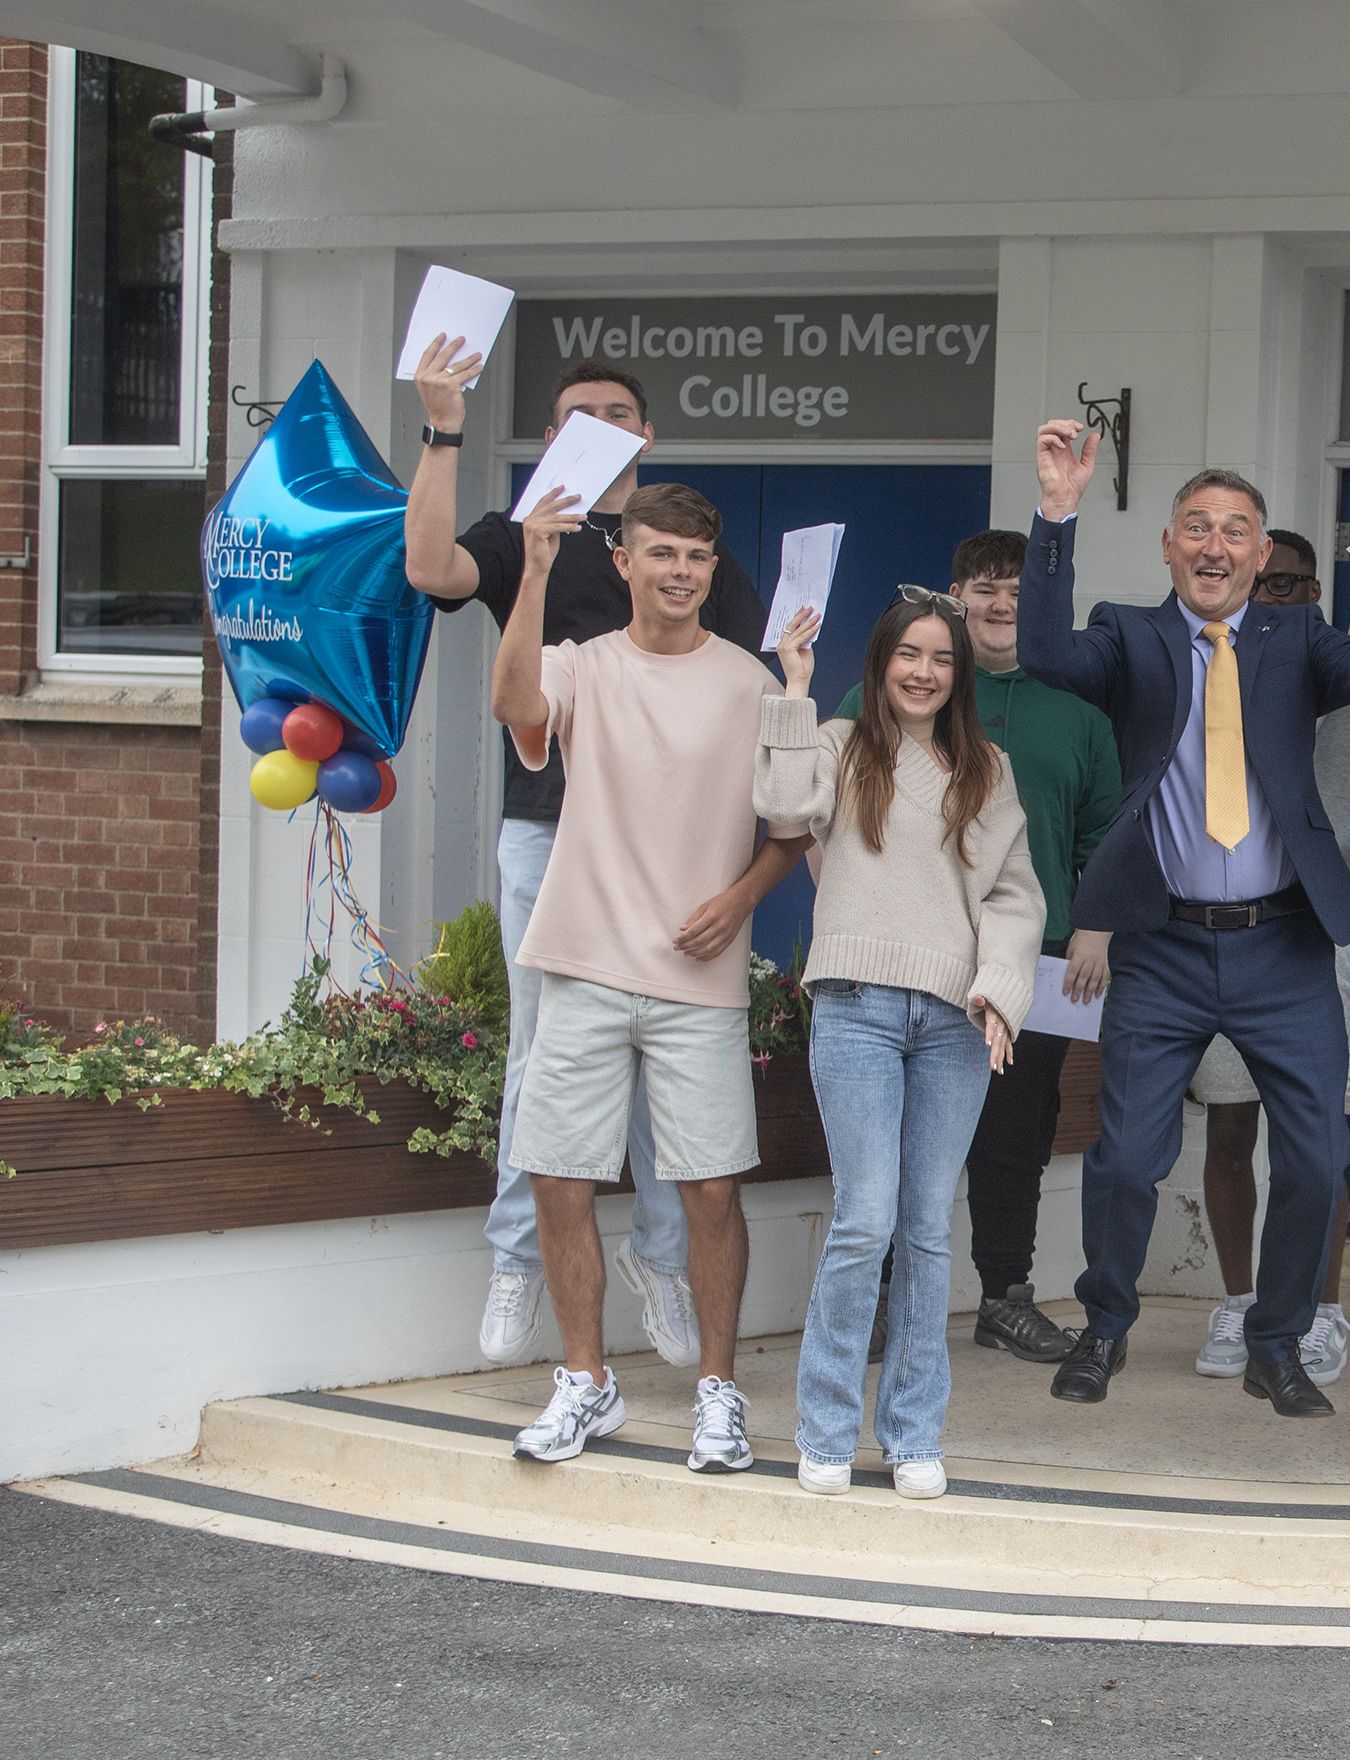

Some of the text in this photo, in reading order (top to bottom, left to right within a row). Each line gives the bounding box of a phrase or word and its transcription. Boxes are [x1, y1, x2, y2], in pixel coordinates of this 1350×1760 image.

[552, 313, 990, 365] Welcome To Mercy
[678, 374, 850, 427] College
[204, 511, 271, 559] MERCY
[206, 546, 293, 589] COLLEGE
